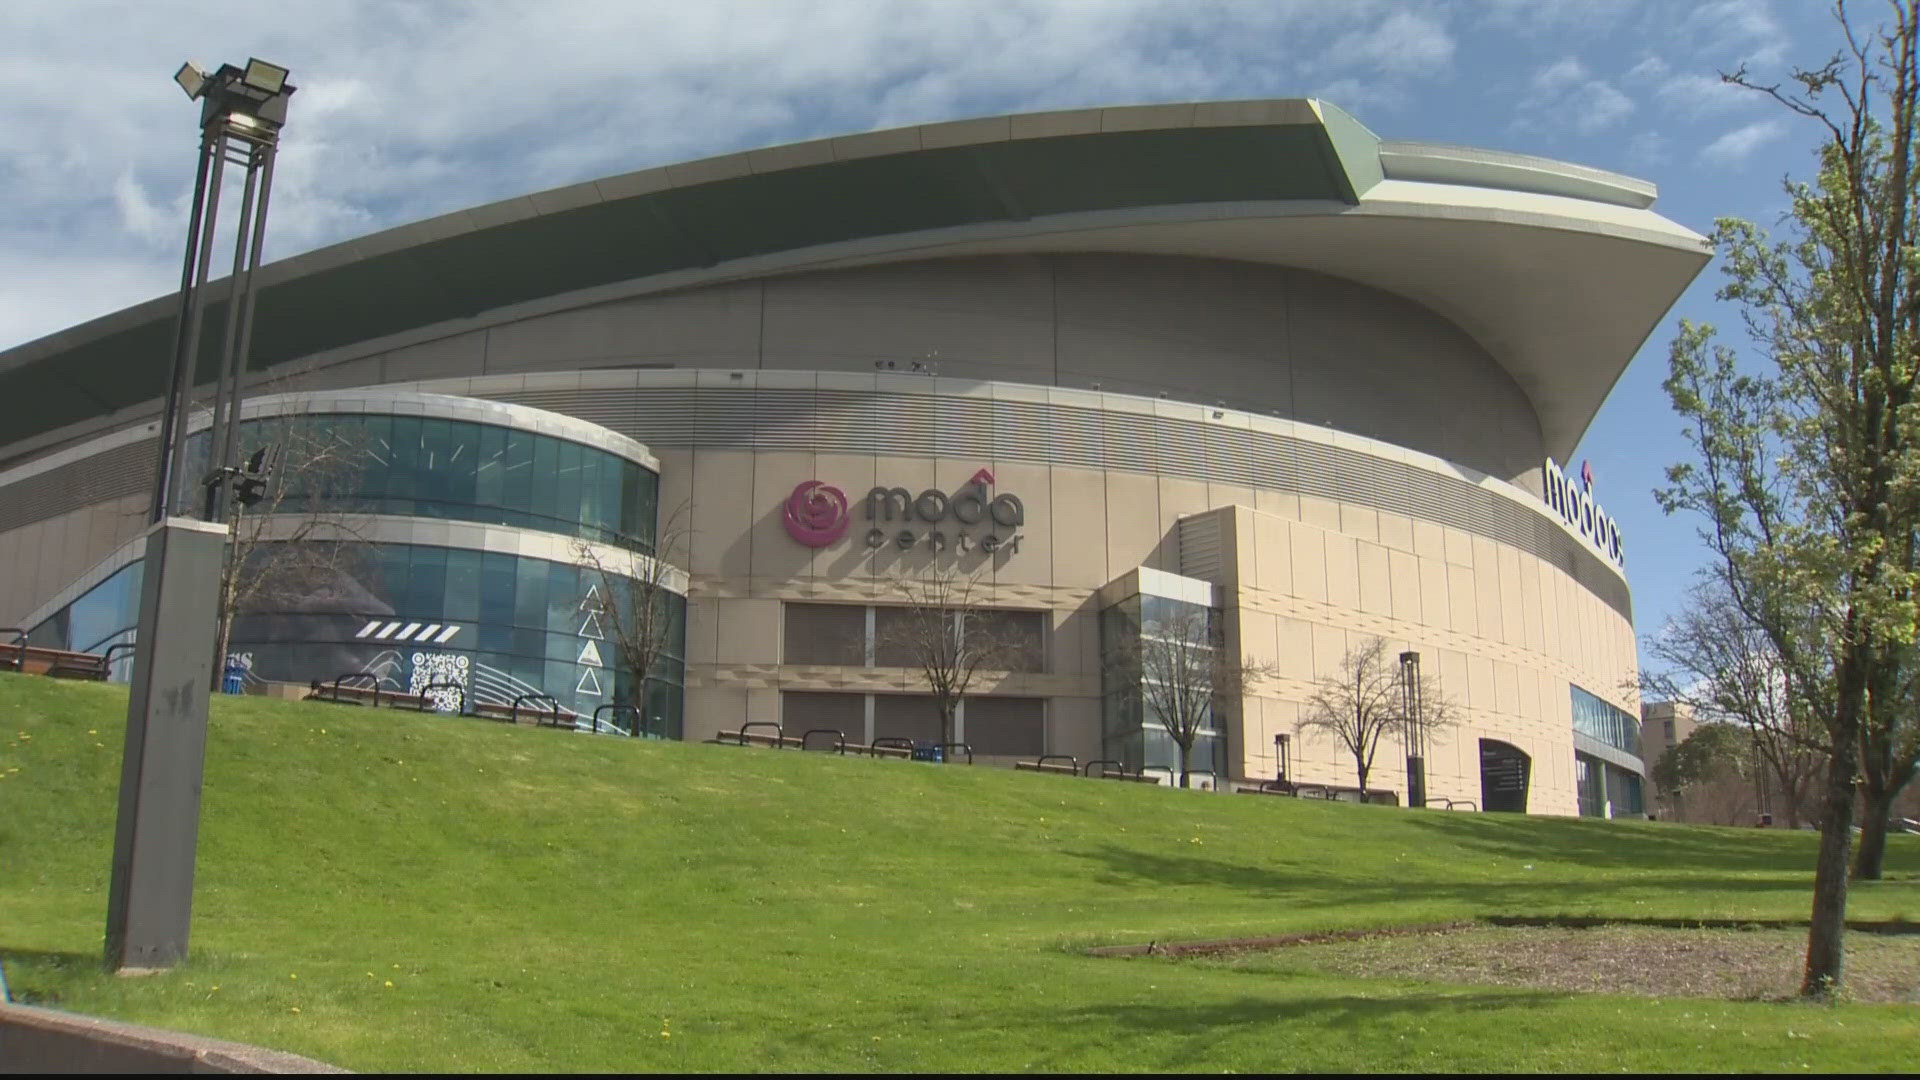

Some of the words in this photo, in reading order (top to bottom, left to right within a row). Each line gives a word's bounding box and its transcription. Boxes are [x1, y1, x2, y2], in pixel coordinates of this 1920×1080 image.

[866, 467, 1025, 527] moda
[1542, 456, 1609, 550] moda
[865, 527, 1024, 554] center
